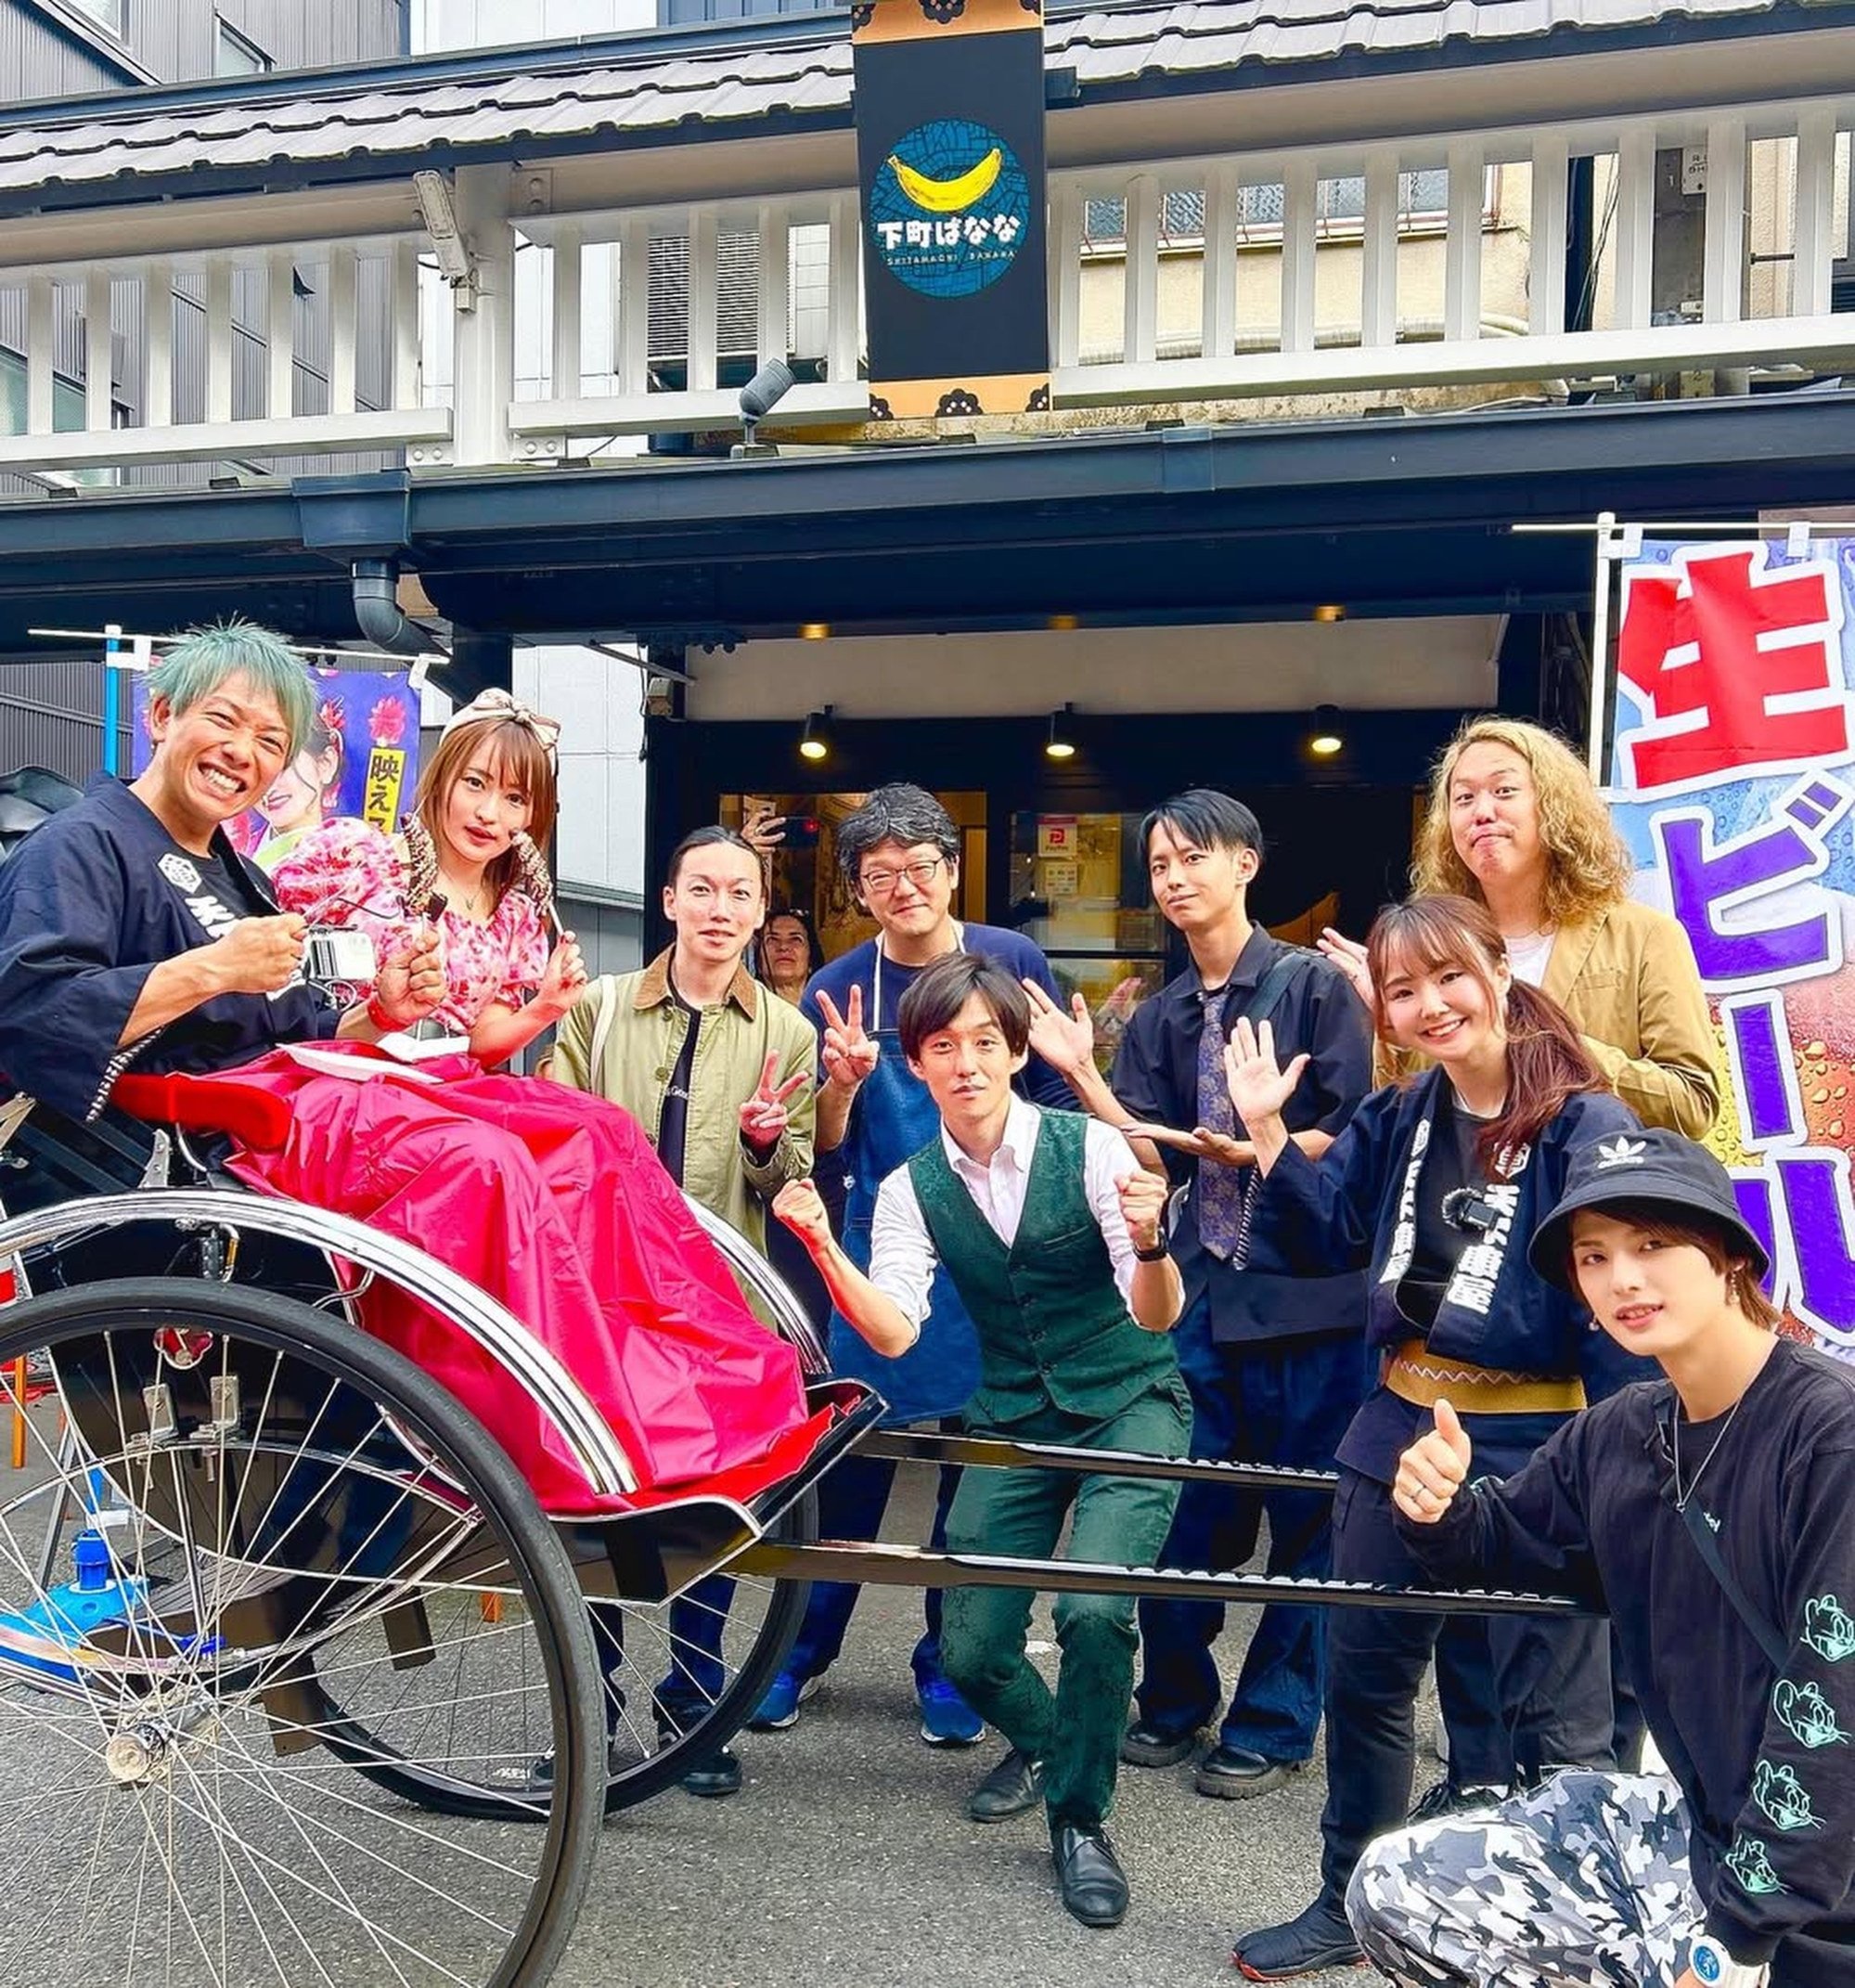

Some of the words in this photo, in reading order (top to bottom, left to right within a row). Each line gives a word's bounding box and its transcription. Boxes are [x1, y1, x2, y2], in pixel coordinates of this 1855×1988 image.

[877, 213, 1021, 250] 下町ばなな
